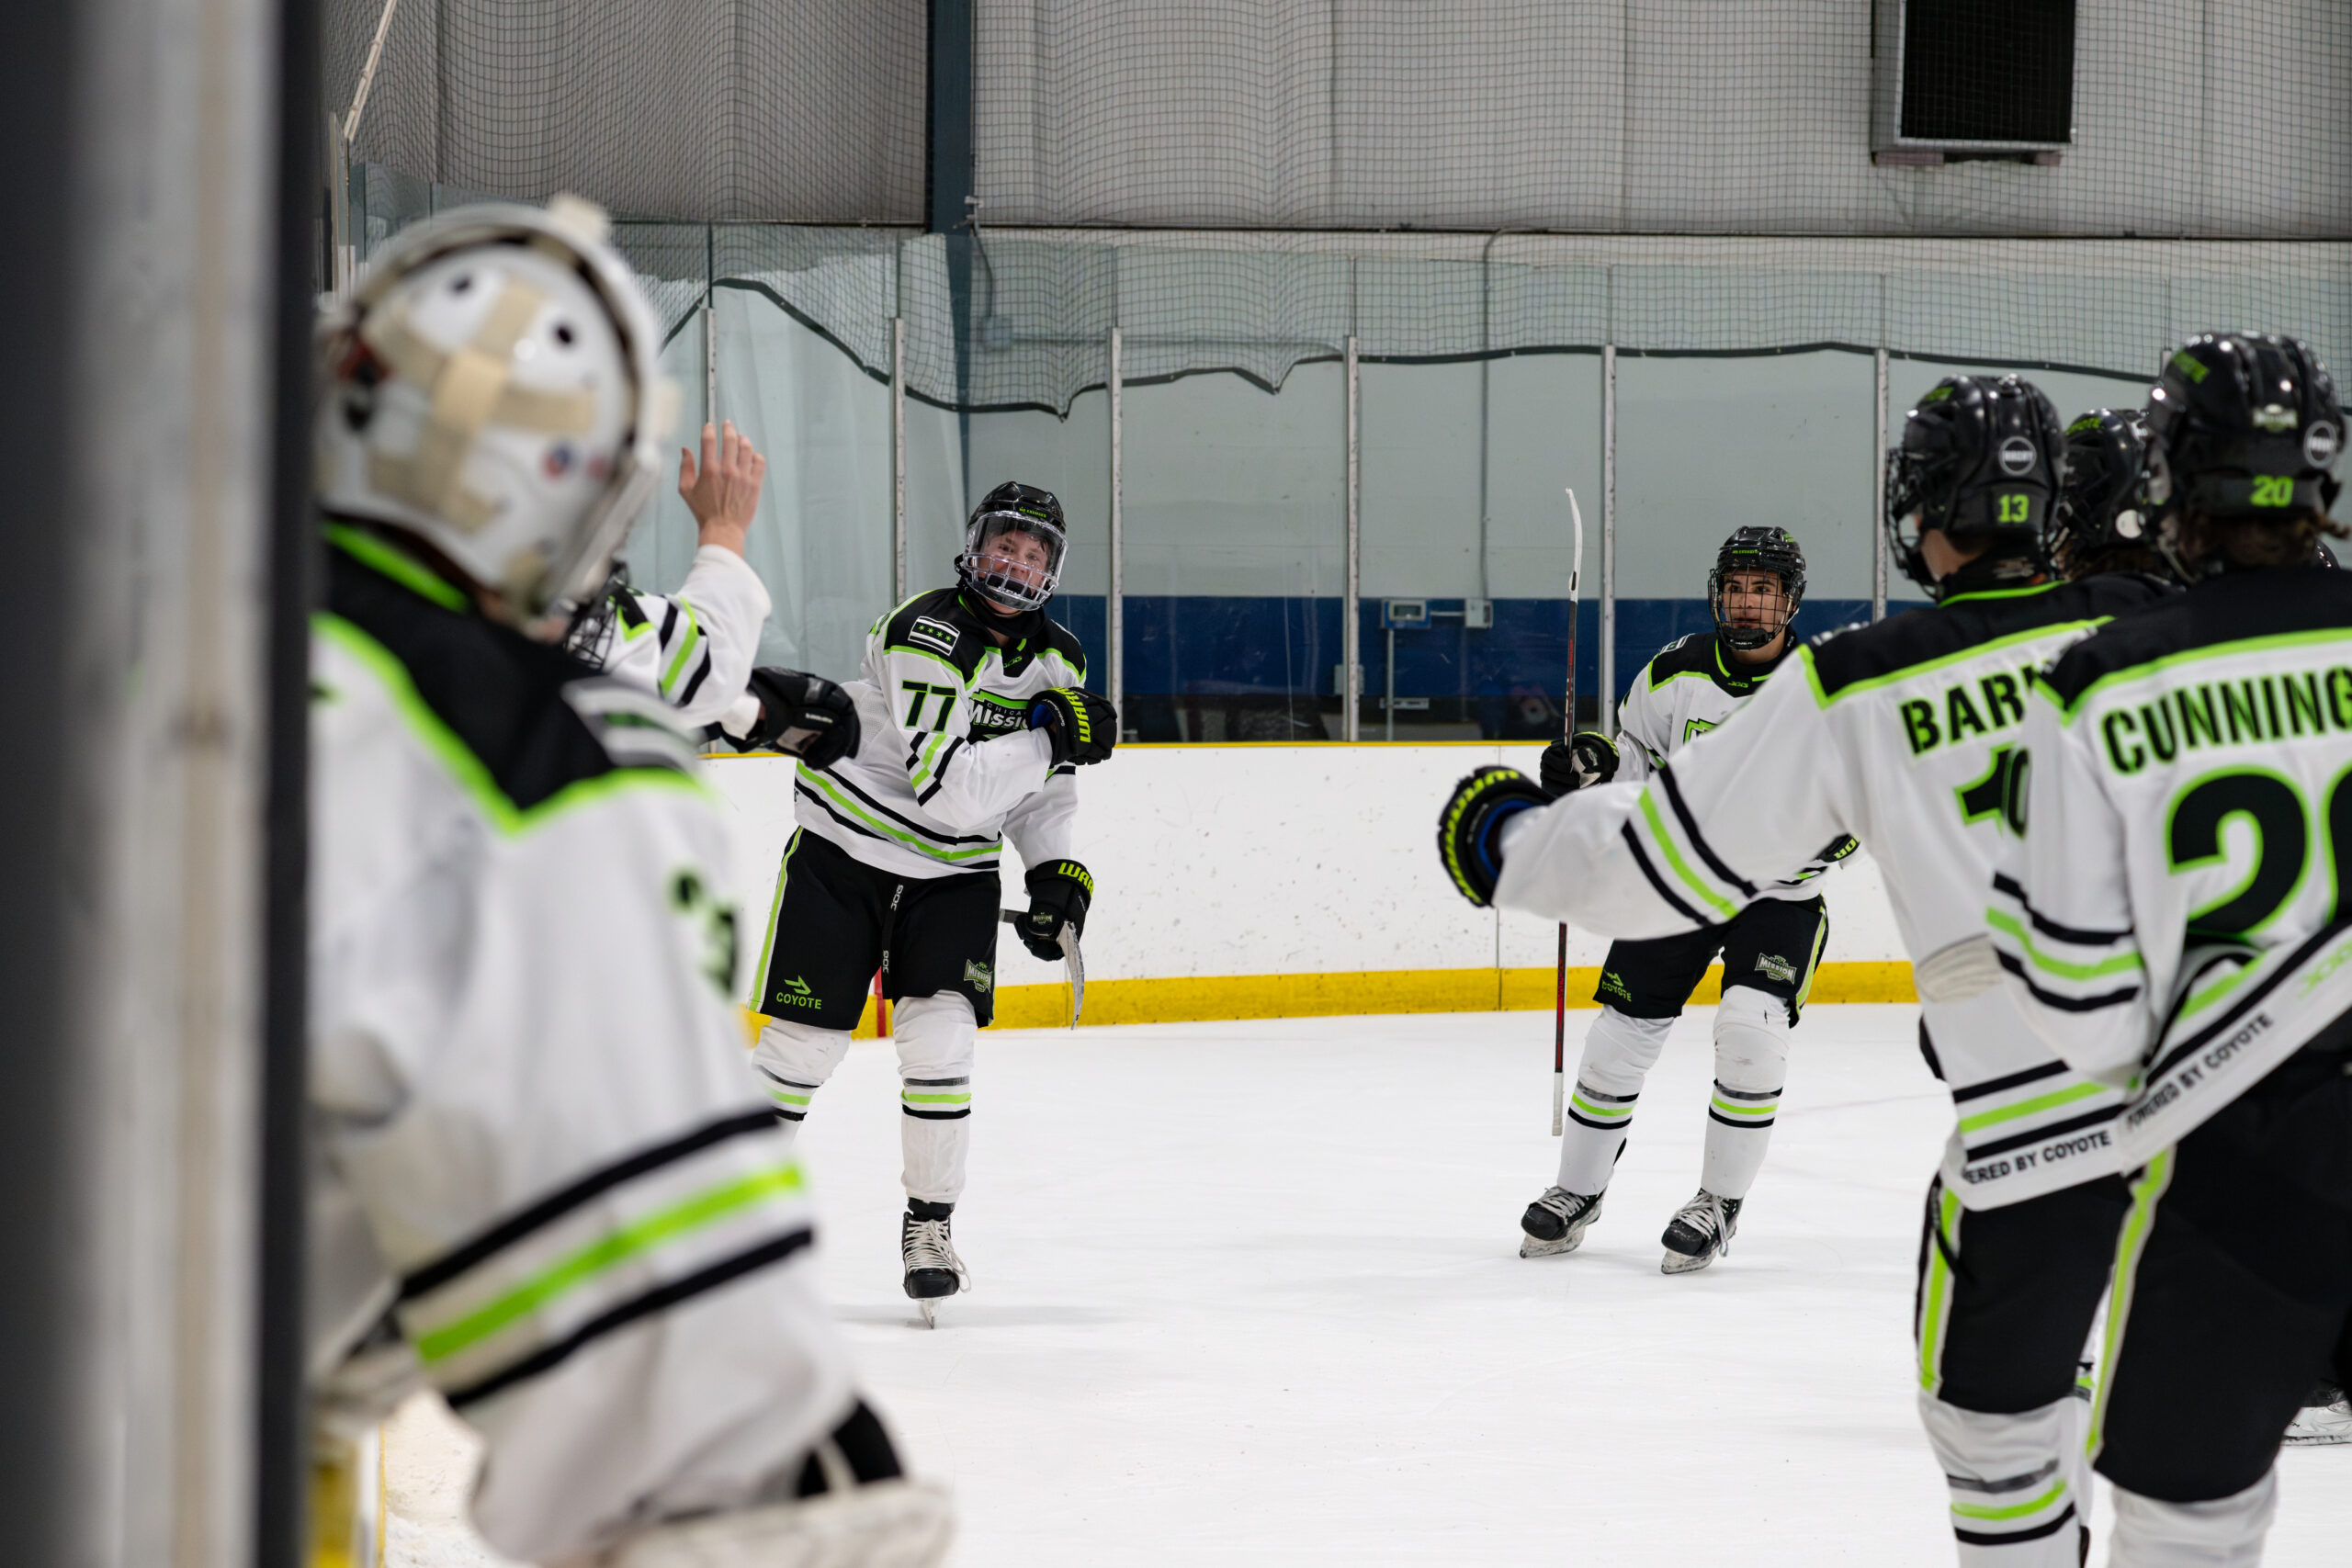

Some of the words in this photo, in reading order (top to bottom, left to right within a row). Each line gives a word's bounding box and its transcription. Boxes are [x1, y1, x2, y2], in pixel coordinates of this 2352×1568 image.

[1998, 493, 2030, 523] 13
[2251, 475, 2295, 507] 20
[901, 680, 957, 733] 77
[987, 702, 1026, 716] CHICA
[1899, 664, 2035, 759] BAR
[2165, 763, 2352, 938] 2
[1758, 956, 1794, 979] MISSION
[776, 992, 822, 1010] COYOTE
[2178, 1064, 2204, 1089] BY
[2205, 1013, 2274, 1069] COYOTE
[2016, 1152, 2038, 1172] BY
[2042, 1130, 2112, 1163] COYOTE
